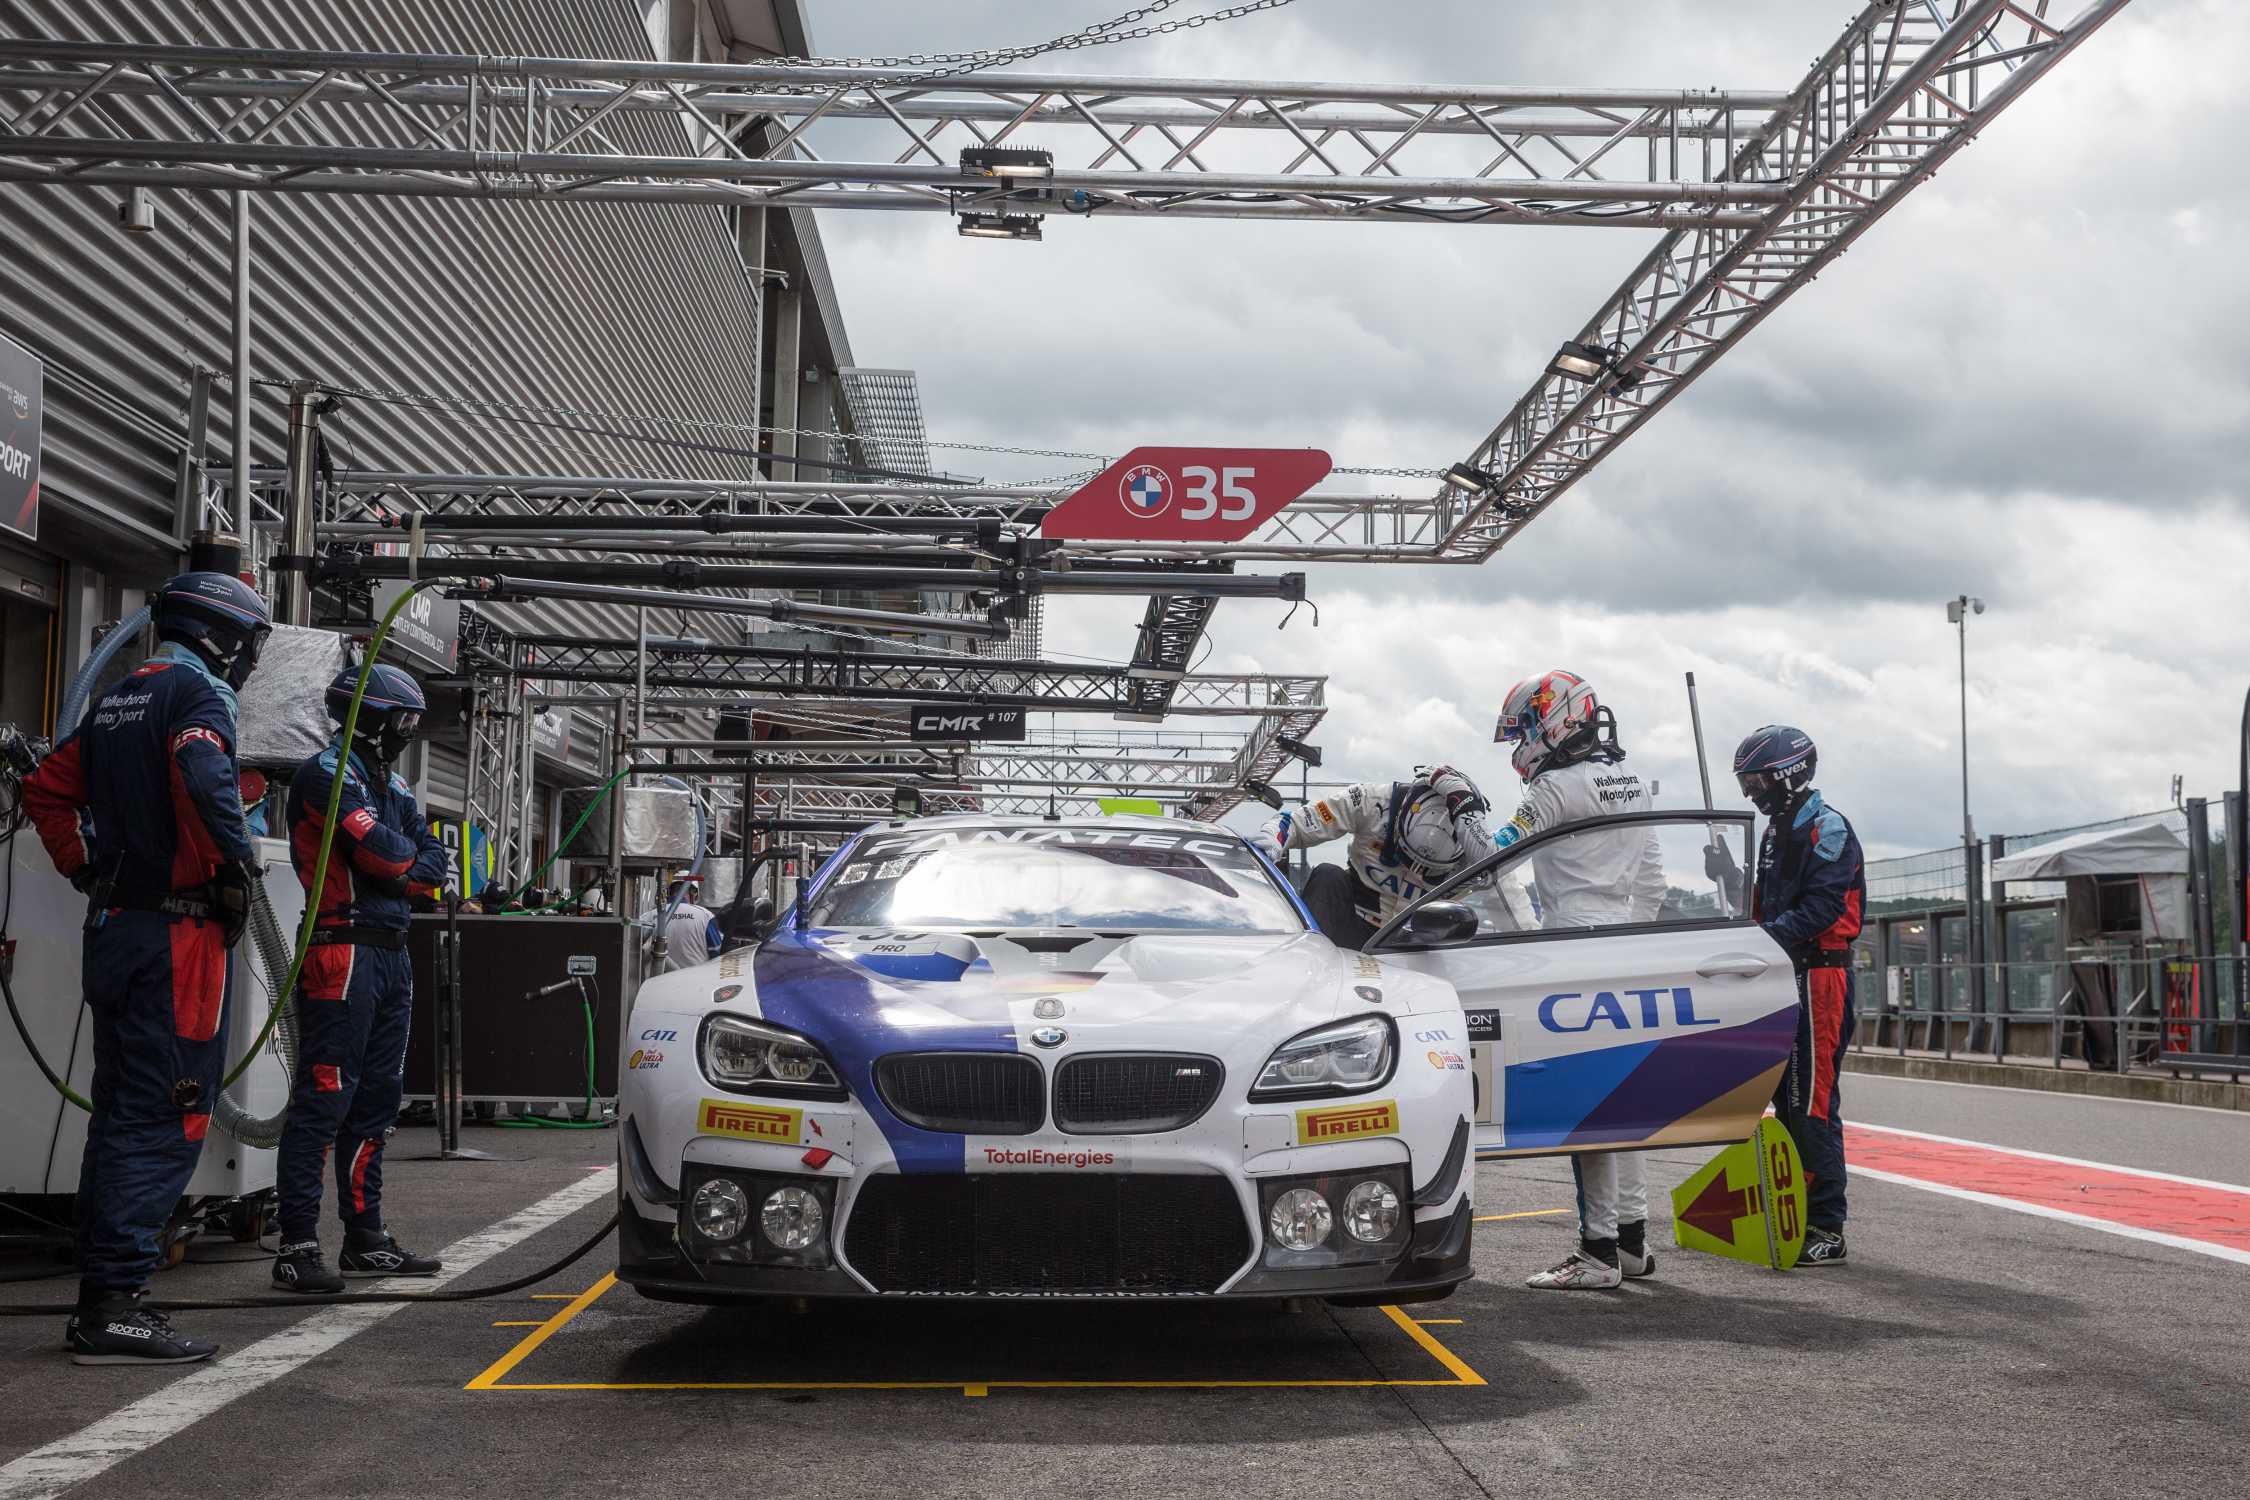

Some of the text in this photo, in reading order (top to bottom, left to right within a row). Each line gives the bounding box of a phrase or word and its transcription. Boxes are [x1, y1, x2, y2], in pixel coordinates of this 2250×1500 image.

[1127, 467, 1166, 482] BMW
[1181, 466, 1256, 521] 35
[411, 592, 431, 627] CMR
[918, 716, 984, 731] CMR
[998, 712, 1017, 722] 107
[1773, 760, 1808, 780] uvex
[864, 829, 1237, 857] FANATEC
[444, 824, 460, 897] CMR
[872, 944, 906, 953] PRO
[1538, 987, 1720, 1033] CATL
[641, 1030, 677, 1041] CATL
[1414, 1030, 1455, 1043] CATL
[706, 1105, 792, 1137] PIRELLI
[1307, 1106, 1389, 1137] PIRELLI
[984, 1149, 1114, 1168] TotalEnergies
[1771, 1141, 1799, 1242] 35
[106, 1322, 152, 1338] sparco
